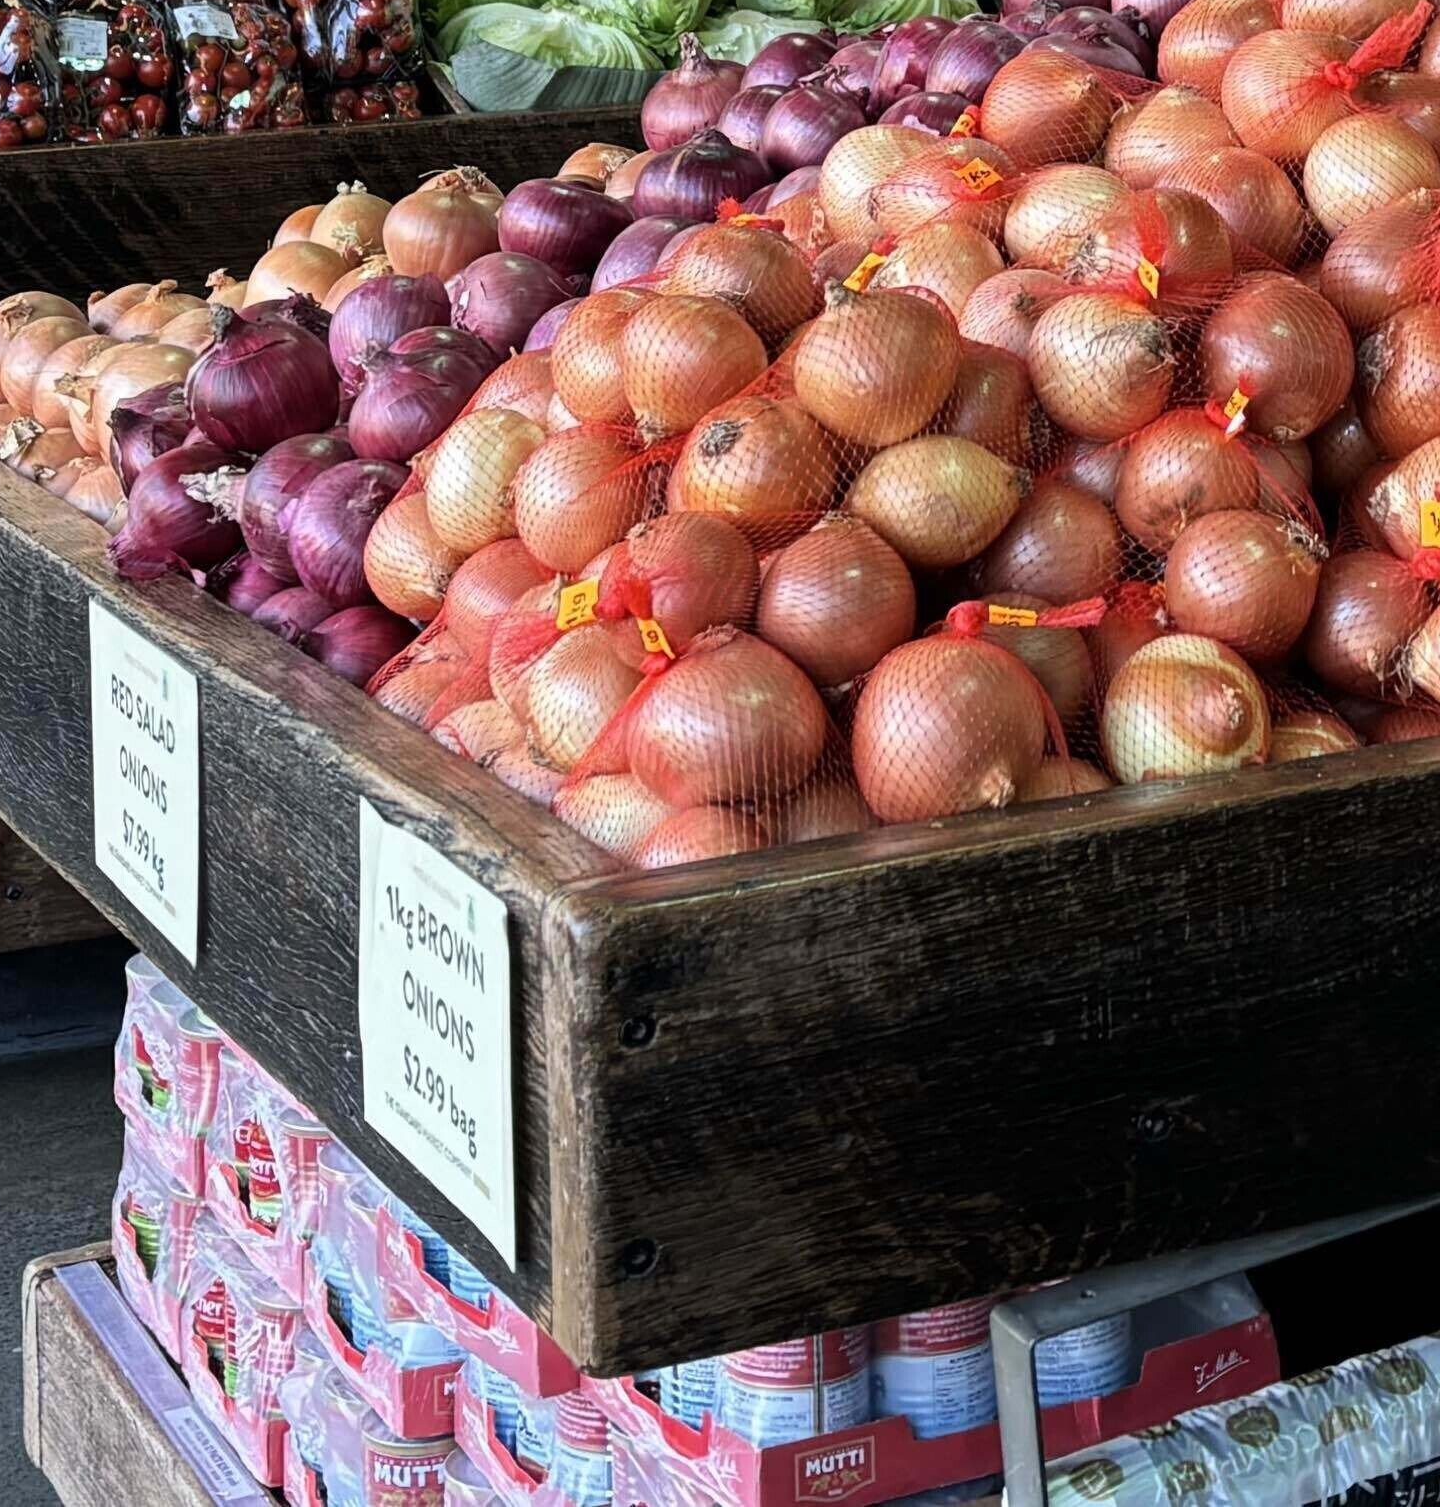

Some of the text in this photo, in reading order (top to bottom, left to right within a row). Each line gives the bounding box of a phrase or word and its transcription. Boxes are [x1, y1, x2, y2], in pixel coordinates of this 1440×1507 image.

[111, 673, 175, 754] RED SALAD
[120, 745, 167, 814] ONIONS
[123, 808, 164, 891] $7.99 kg
[386, 885, 485, 994] 1kg BROWN
[403, 970, 475, 1063] ONIONS
[404, 1044, 477, 1160] $2.99 bag
[805, 1448, 865, 1477] MUTTI
